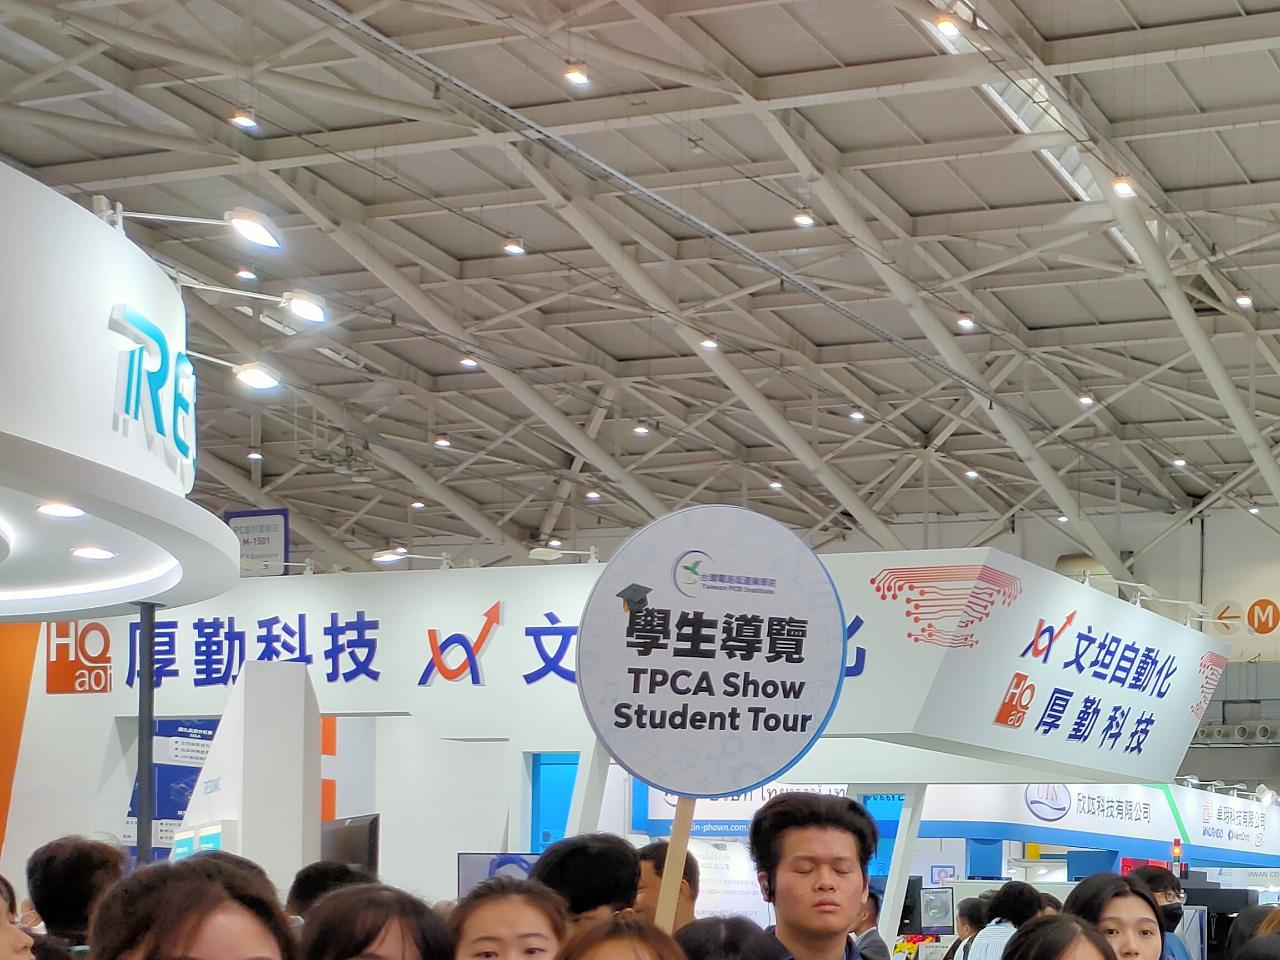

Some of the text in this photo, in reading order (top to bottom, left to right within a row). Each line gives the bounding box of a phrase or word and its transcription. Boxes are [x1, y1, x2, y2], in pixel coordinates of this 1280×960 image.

[626, 607, 808, 664] 學生導覽
[1254, 605, 1273, 628] M
[627, 667, 806, 700] TPCA Show
[1062, 624, 1178, 699] 文坦自動化
[613, 702, 813, 732] Student Tour
[1035, 687, 1156, 755] 厚勤科技
